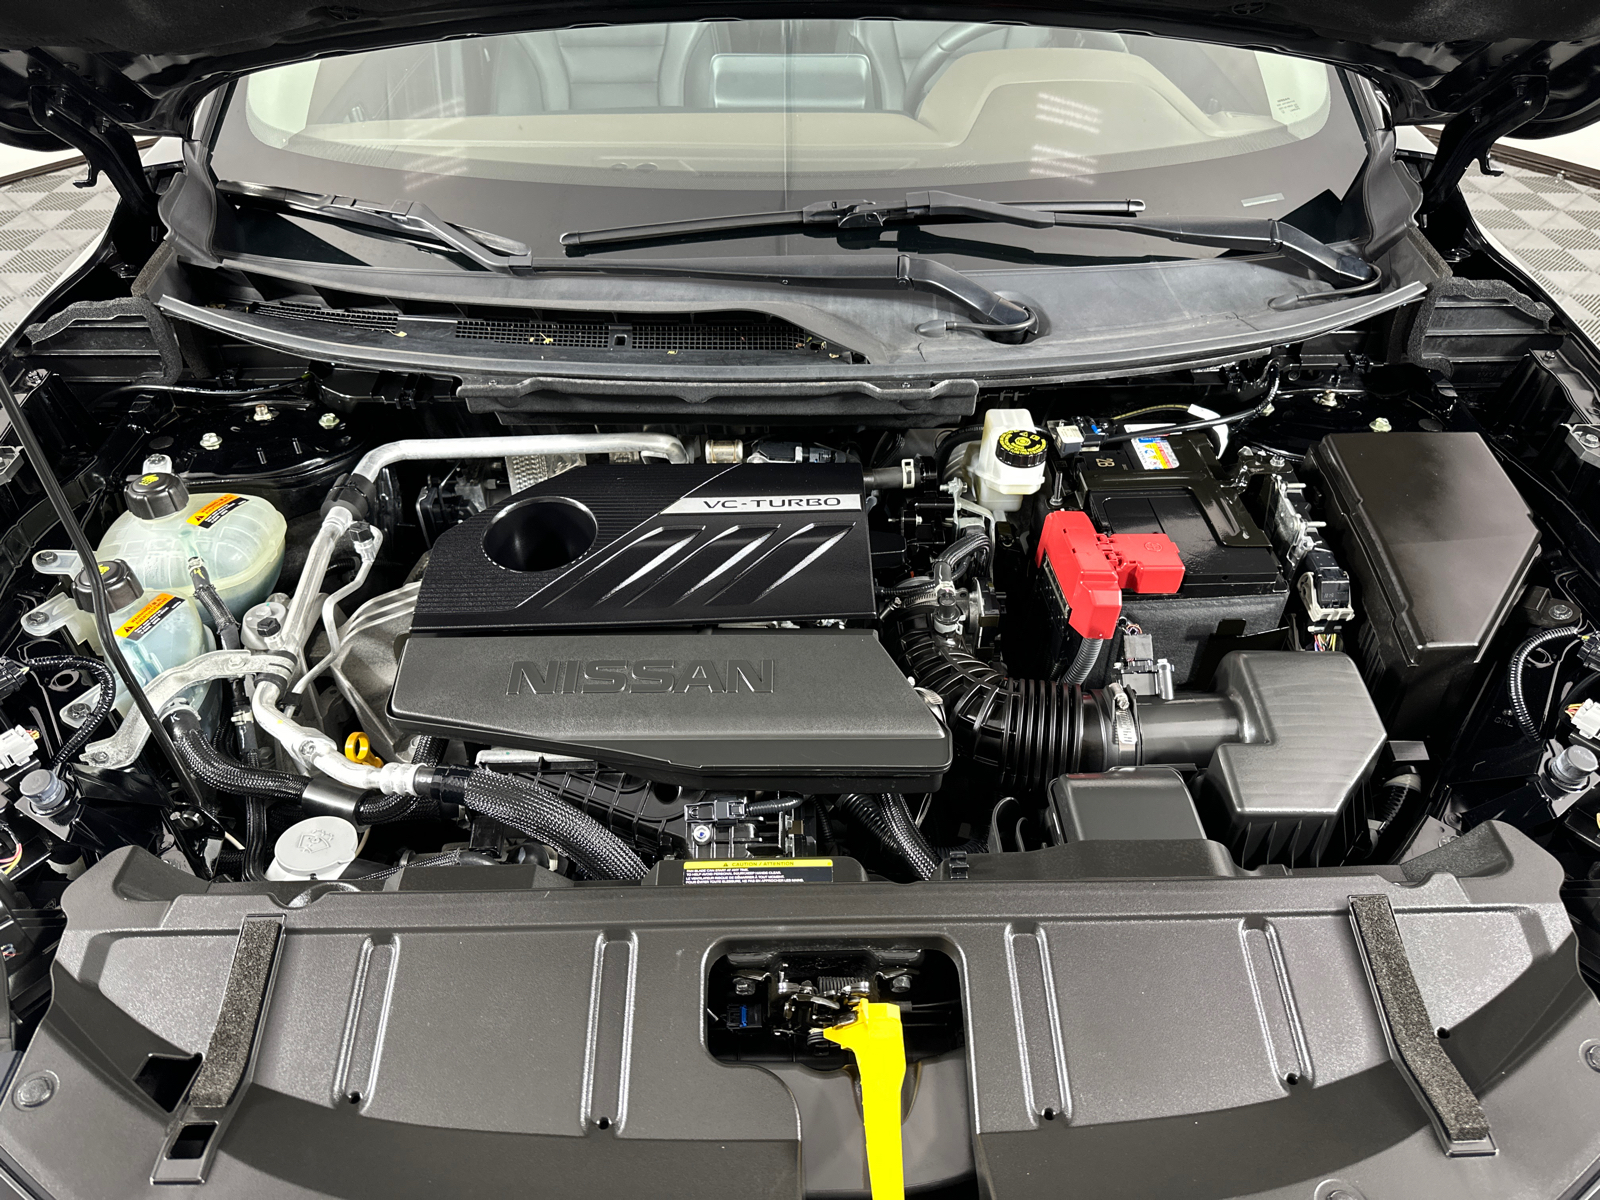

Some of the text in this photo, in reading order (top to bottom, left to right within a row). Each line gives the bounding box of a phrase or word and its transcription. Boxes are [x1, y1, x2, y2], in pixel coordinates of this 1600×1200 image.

[1096, 457, 1115, 468] 2B
[703, 496, 841, 509] VC-TURBO
[505, 659, 775, 695] NISSAN
